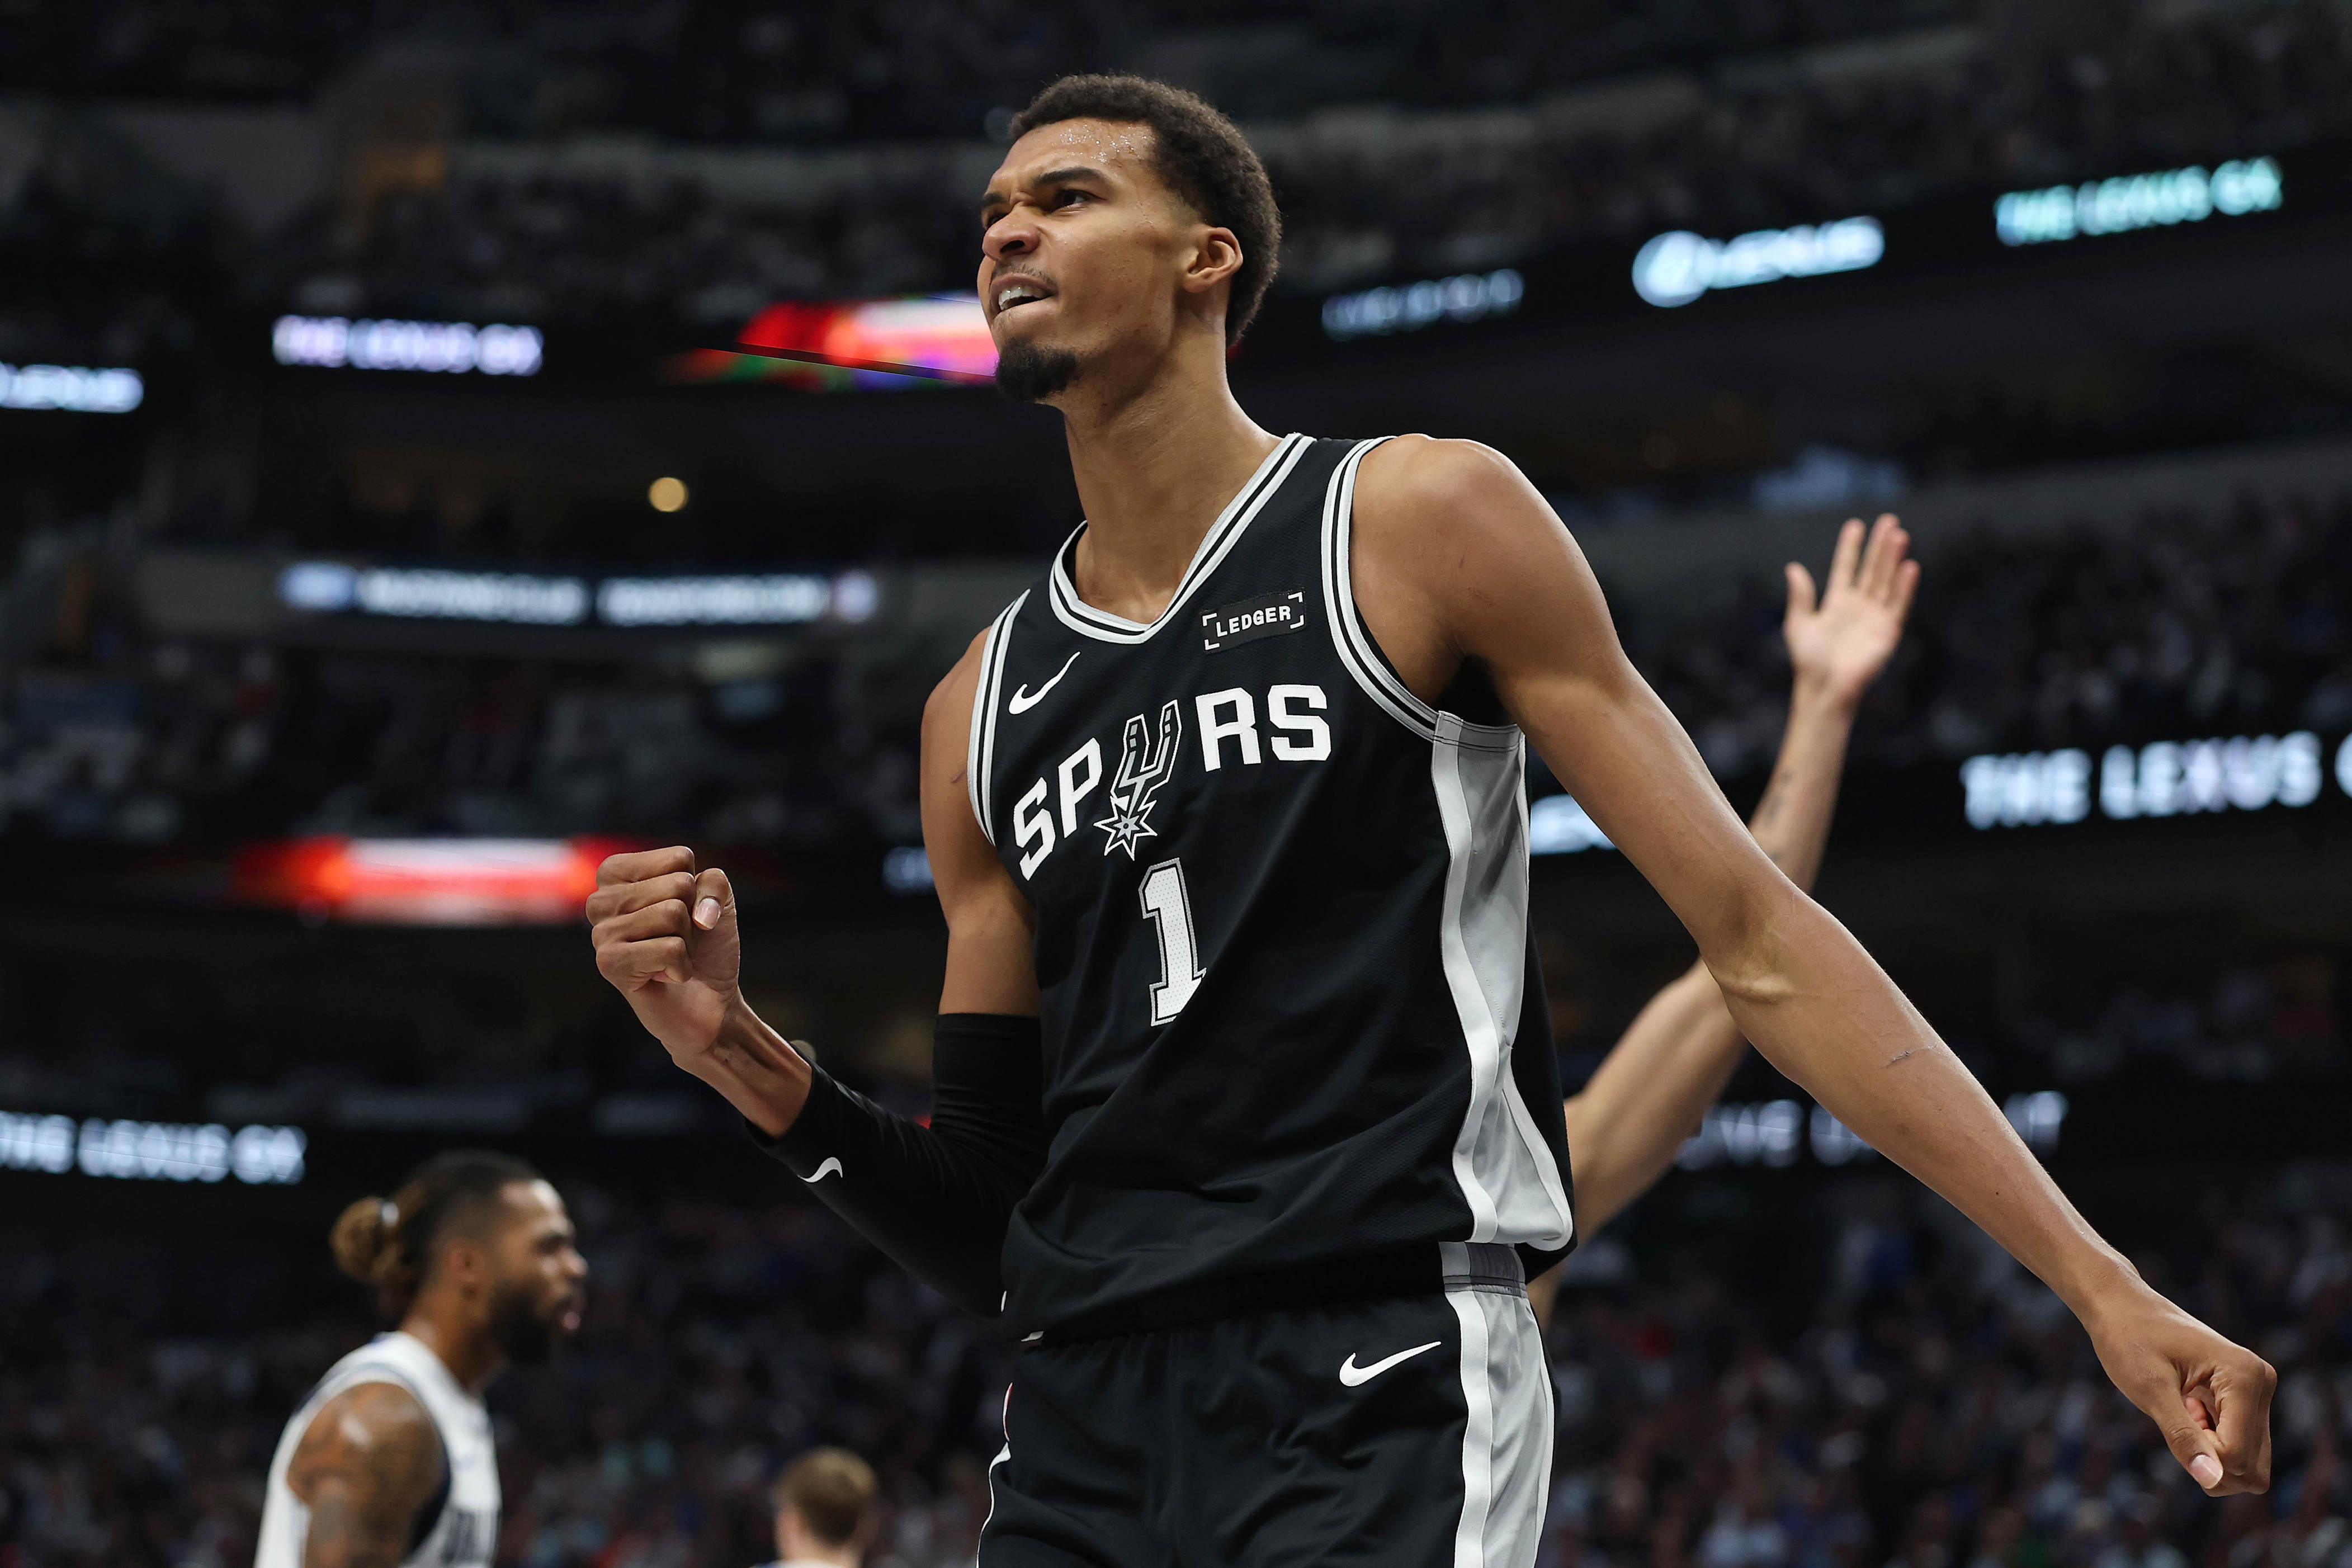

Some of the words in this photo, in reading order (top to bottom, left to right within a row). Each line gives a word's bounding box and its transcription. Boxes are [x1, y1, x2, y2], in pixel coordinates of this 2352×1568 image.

[1216, 604, 1292, 639] LEDGER
[1013, 683, 1331, 881] SPURS
[1961, 747, 2091, 829] THE
[2099, 731, 2322, 820] LEXUS
[1137, 857, 1207, 1027] 1
